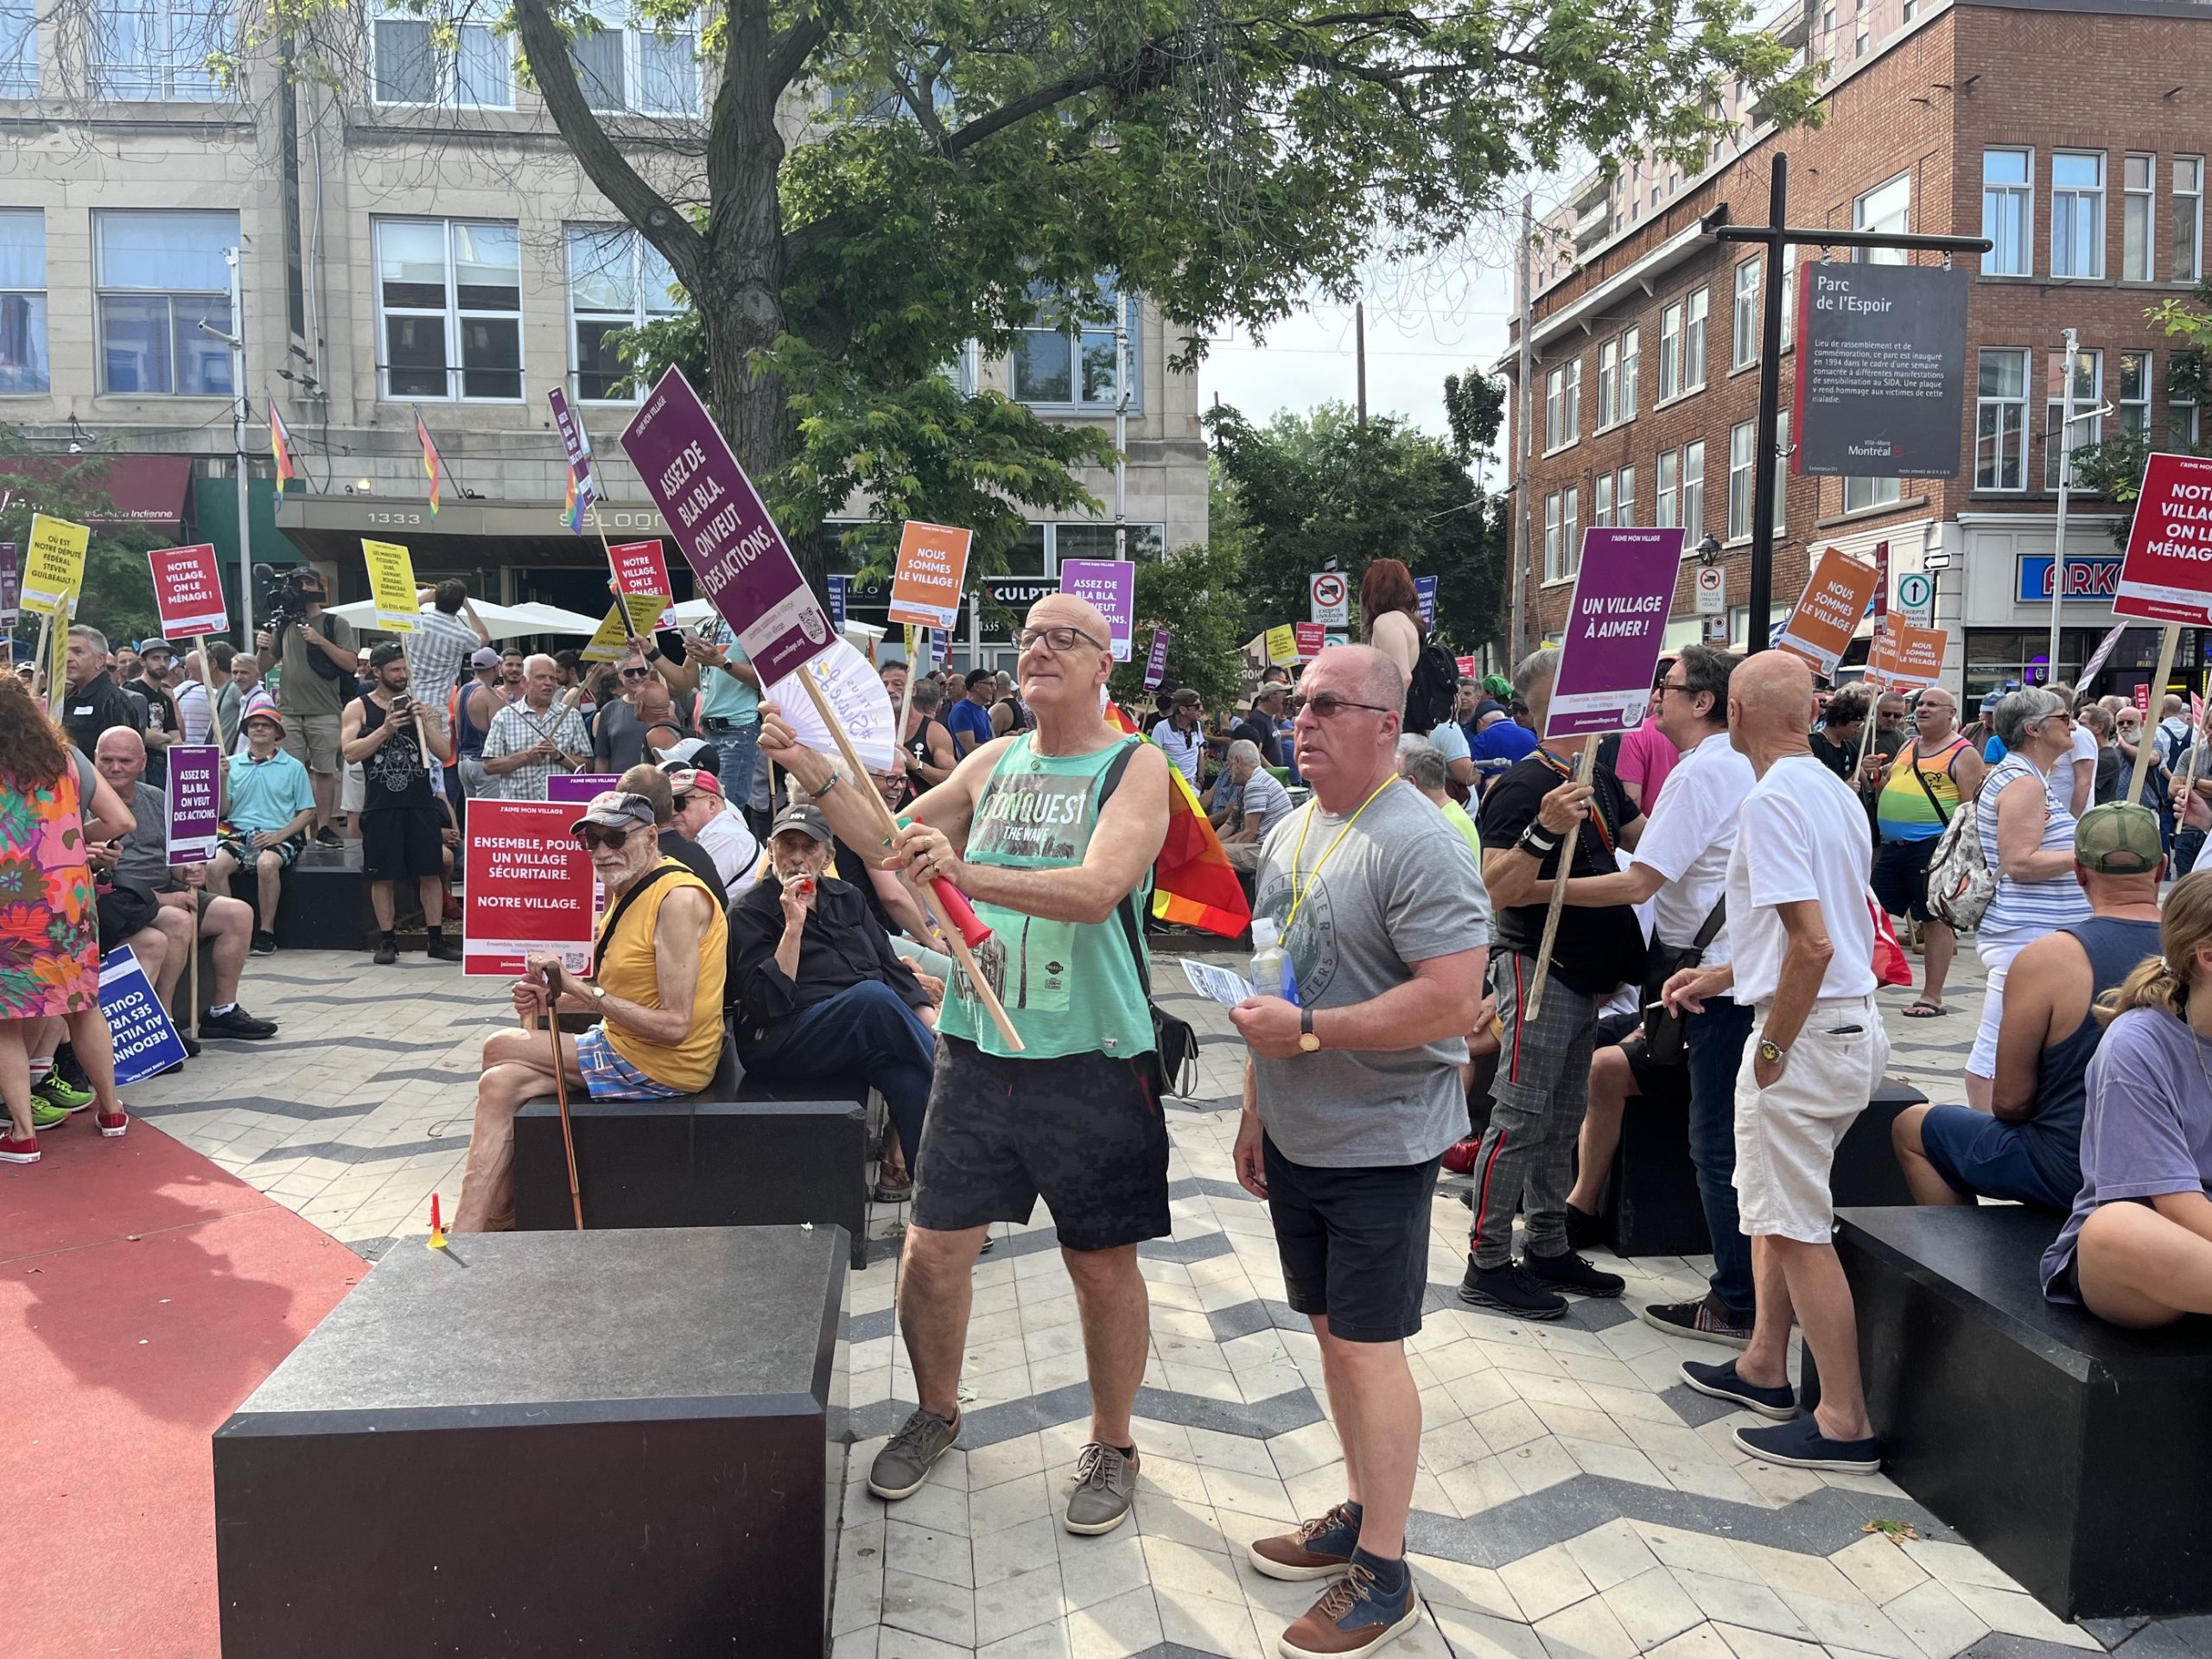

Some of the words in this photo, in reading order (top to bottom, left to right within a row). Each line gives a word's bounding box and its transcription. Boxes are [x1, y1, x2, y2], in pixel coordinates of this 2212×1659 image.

[1818, 276, 1849, 291] Parc
[1817, 296, 1833, 309] de
[1840, 296, 1891, 315] l'Espoir
[1815, 349, 1872, 359] commémoration,
[1912, 352, 1942, 361] inauguré
[1894, 371, 1943, 379] manifestations
[1836, 387, 1869, 397] hommage
[1885, 388, 1914, 397] victimes
[651, 396, 667, 418] VILLAGE
[1848, 446, 1891, 456] Montréal
[659, 455, 690, 501] ASSEZ
[687, 440, 707, 474] DE
[677, 491, 702, 528] BLA
[696, 476, 726, 514] BLA.
[368, 512, 420, 524] 1333
[695, 527, 715, 558] ON
[709, 502, 742, 546] VEUT
[2166, 524, 2195, 540] ON
[60, 537, 70, 546] EST
[35, 542, 56, 552] NOTRE
[58, 546, 81, 559] DÉPUTÉ
[918, 548, 946, 560] NOUS
[44, 554, 70, 565] FÉDÉRAL
[168, 561, 199, 571] NOTRE
[623, 556, 650, 568] NOTRE
[703, 561, 728, 595] DES
[720, 524, 775, 581] ACTIONS.
[43, 563, 67, 574] STEVEN
[622, 566, 657, 579] VILLAGE,
[908, 560, 950, 574] SOMMES
[32, 570, 71, 584] GUILBEAULT
[166, 570, 207, 582] VILLAGE,
[629, 580, 642, 588] ON
[644, 577, 653, 586] LE
[899, 571, 910, 581] LE
[912, 573, 953, 588] VILLAGE
[174, 583, 188, 592] ON
[1073, 580, 1102, 588] ASSEZ
[1104, 581, 1117, 589] DE
[1827, 581, 1854, 601] NOUS
[168, 592, 207, 604] MÉNAGE
[1076, 591, 1093, 601] BLA
[1096, 591, 1117, 601] BLA.
[1582, 598, 1604, 614] UN
[1607, 596, 1662, 613] VILLAGE
[1815, 592, 1853, 617] SOMMES
[1802, 602, 1814, 615] LE
[1815, 607, 1851, 632] VILLAGE
[1585, 618, 1595, 639] À
[1598, 620, 1640, 638] AIMER
[180, 770, 200, 780] ASSEZ
[200, 770, 209, 779] DE
[182, 784, 195, 793] BLA
[196, 783, 211, 792] BLA.
[181, 797, 192, 807] ON
[194, 796, 210, 806] VEUT
[981, 791, 1087, 825] CONQUEST
[174, 811, 187, 821] DES
[188, 809, 216, 820] ACTIONS.
[1003, 826, 1022, 841] THE
[1022, 827, 1051, 842] WAVE
[474, 836, 543, 851] ENSEMBLE,
[546, 839, 582, 852] POUR
[493, 853, 512, 863] UN
[514, 853, 568, 865] VILLAGE
[488, 865, 571, 881] SÉCURITAIRE.
[477, 897, 521, 908] NOTRE
[524, 898, 581, 910] VILLAGE.
[130, 1003, 153, 1020] SES
[146, 1014, 163, 1030] AU
[113, 1028, 168, 1065] REDONN
